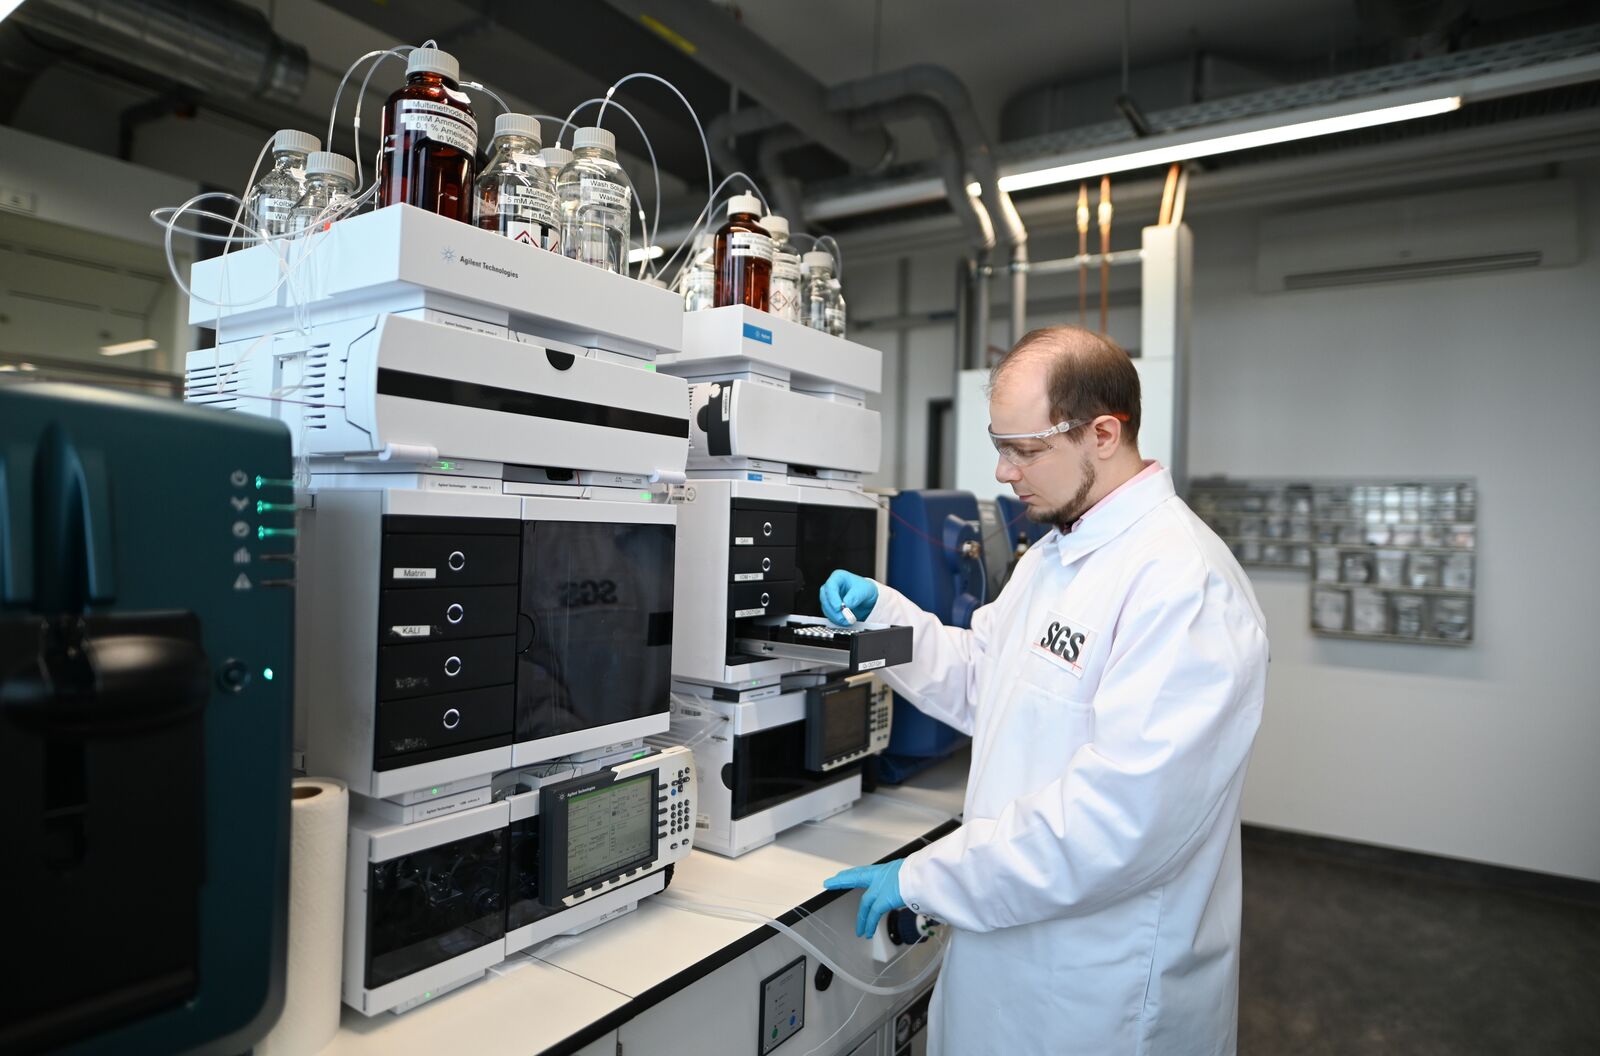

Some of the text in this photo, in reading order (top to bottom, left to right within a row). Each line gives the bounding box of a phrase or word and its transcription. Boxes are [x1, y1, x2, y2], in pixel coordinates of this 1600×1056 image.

[412, 101, 463, 118] Multimethode
[430, 123, 439, 132] %
[590, 180, 609, 188] Wash
[513, 197, 528, 205] mM
[599, 193, 622, 203] Wasser
[531, 211, 538, 219] in
[460, 255, 519, 279] Agilent Technologies
[1040, 620, 1086, 663] SGS
